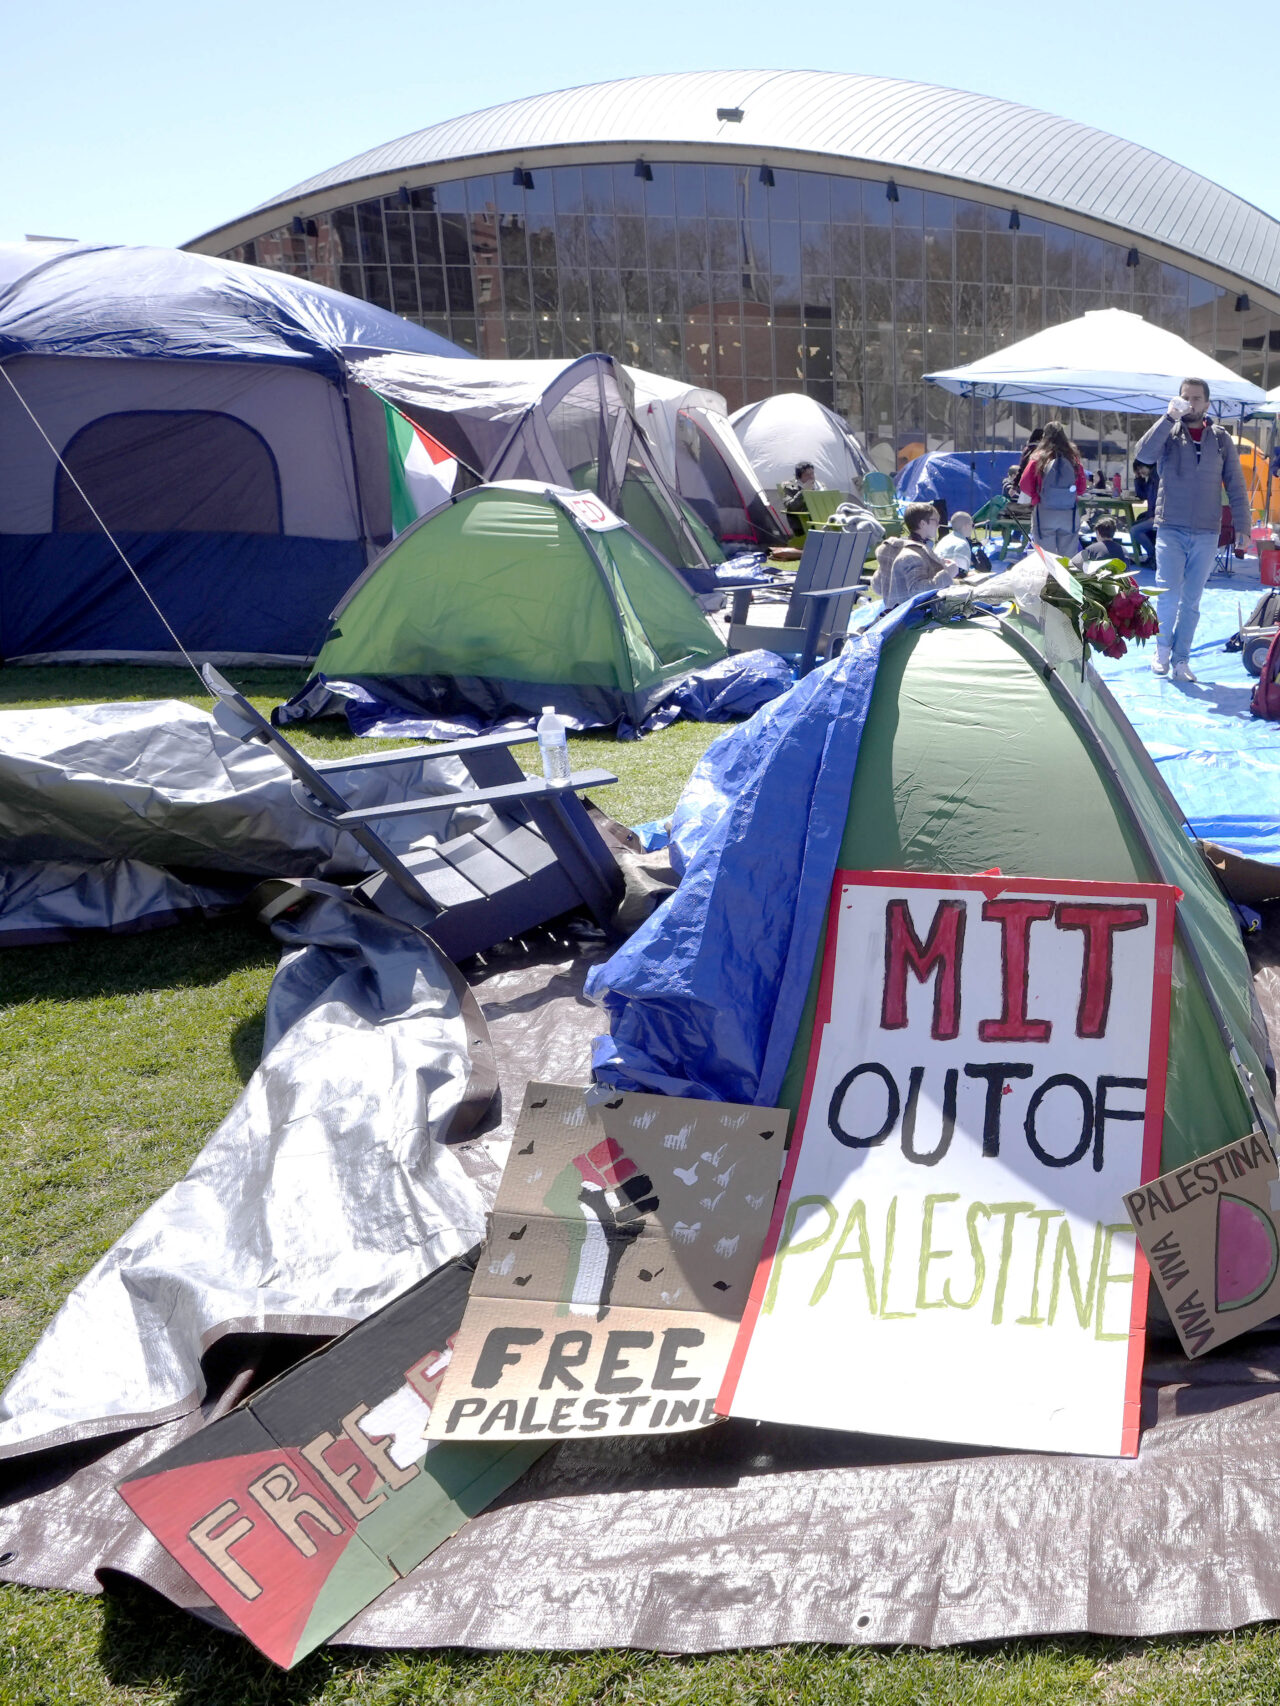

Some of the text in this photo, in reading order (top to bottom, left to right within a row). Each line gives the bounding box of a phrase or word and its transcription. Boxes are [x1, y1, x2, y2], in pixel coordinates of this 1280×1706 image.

[879, 898, 1149, 1043] MIT
[1127, 1136, 1271, 1227] PALESTINA
[761, 1192, 1138, 1341] PALESTINE
[1150, 1230, 1216, 1356] VIVA VIVA
[444, 1396, 723, 1435] PALESTINE
[471, 1326, 705, 1393] FREE
[187, 1401, 422, 1602] FREE
